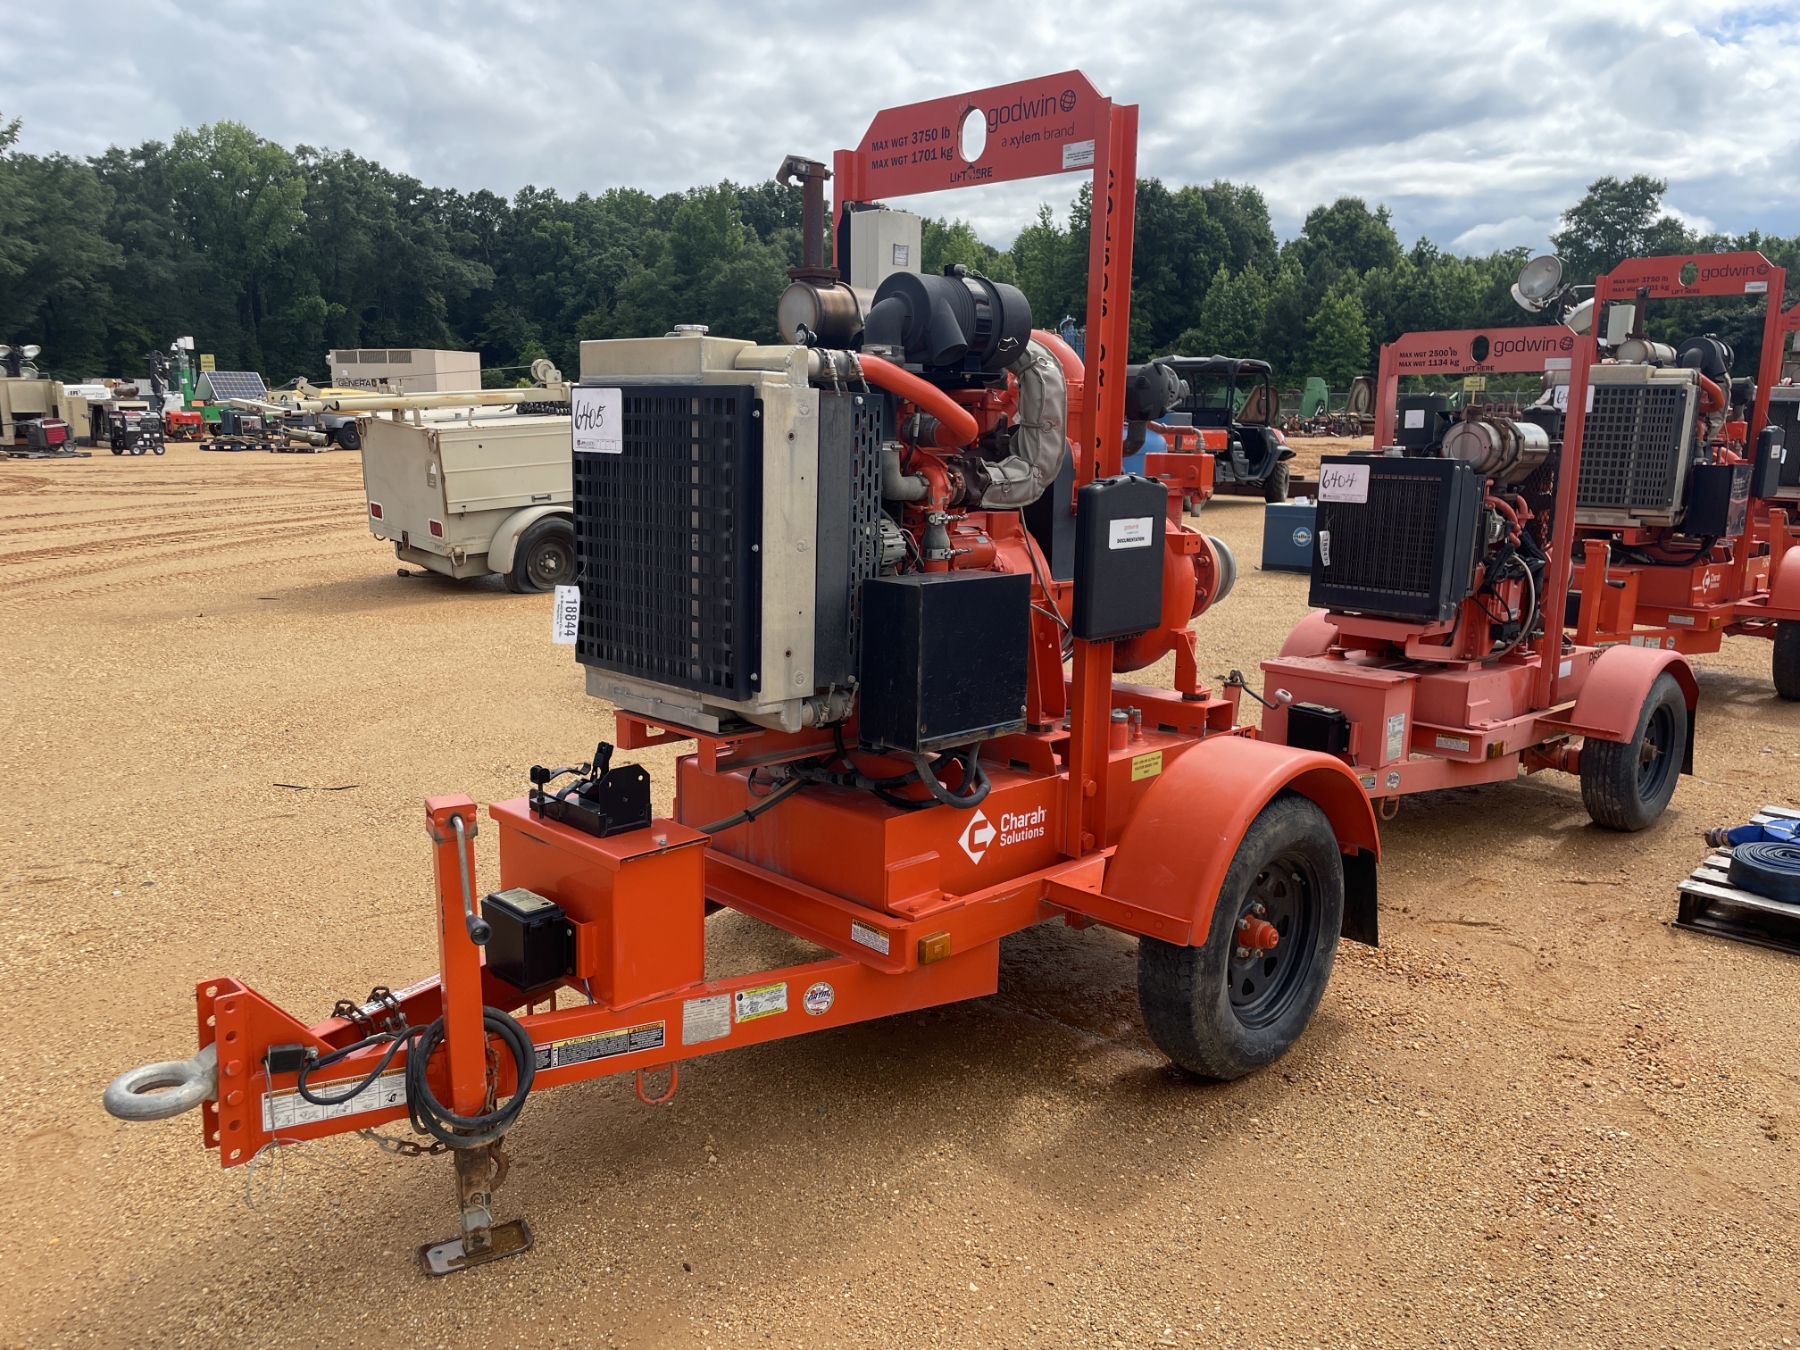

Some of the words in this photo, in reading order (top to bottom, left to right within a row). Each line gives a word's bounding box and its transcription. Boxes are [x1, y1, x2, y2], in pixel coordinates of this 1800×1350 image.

[988, 94, 1056, 133] godwin
[872, 140, 888, 151] MAX
[891, 136, 908, 148] WGT
[911, 128, 938, 144] 3750
[942, 127, 950, 139] lb
[1002, 138, 1007, 147] a
[1010, 131, 1040, 149] xylem
[1044, 121, 1074, 140] brand
[872, 158, 888, 170] MAX
[891, 155, 908, 166] WGT
[911, 148, 937, 163] 1701
[940, 146, 953, 160] kg
[950, 171, 967, 182] LIFT
[1702, 264, 1754, 281] godwin
[1494, 336, 1556, 357] godwin
[575, 400, 606, 430] 6405
[1322, 469, 1357, 489] 6404
[564, 598, 577, 636] 18844
[1001, 805, 1046, 832] Charah
[1000, 826, 1044, 847] Solutions
